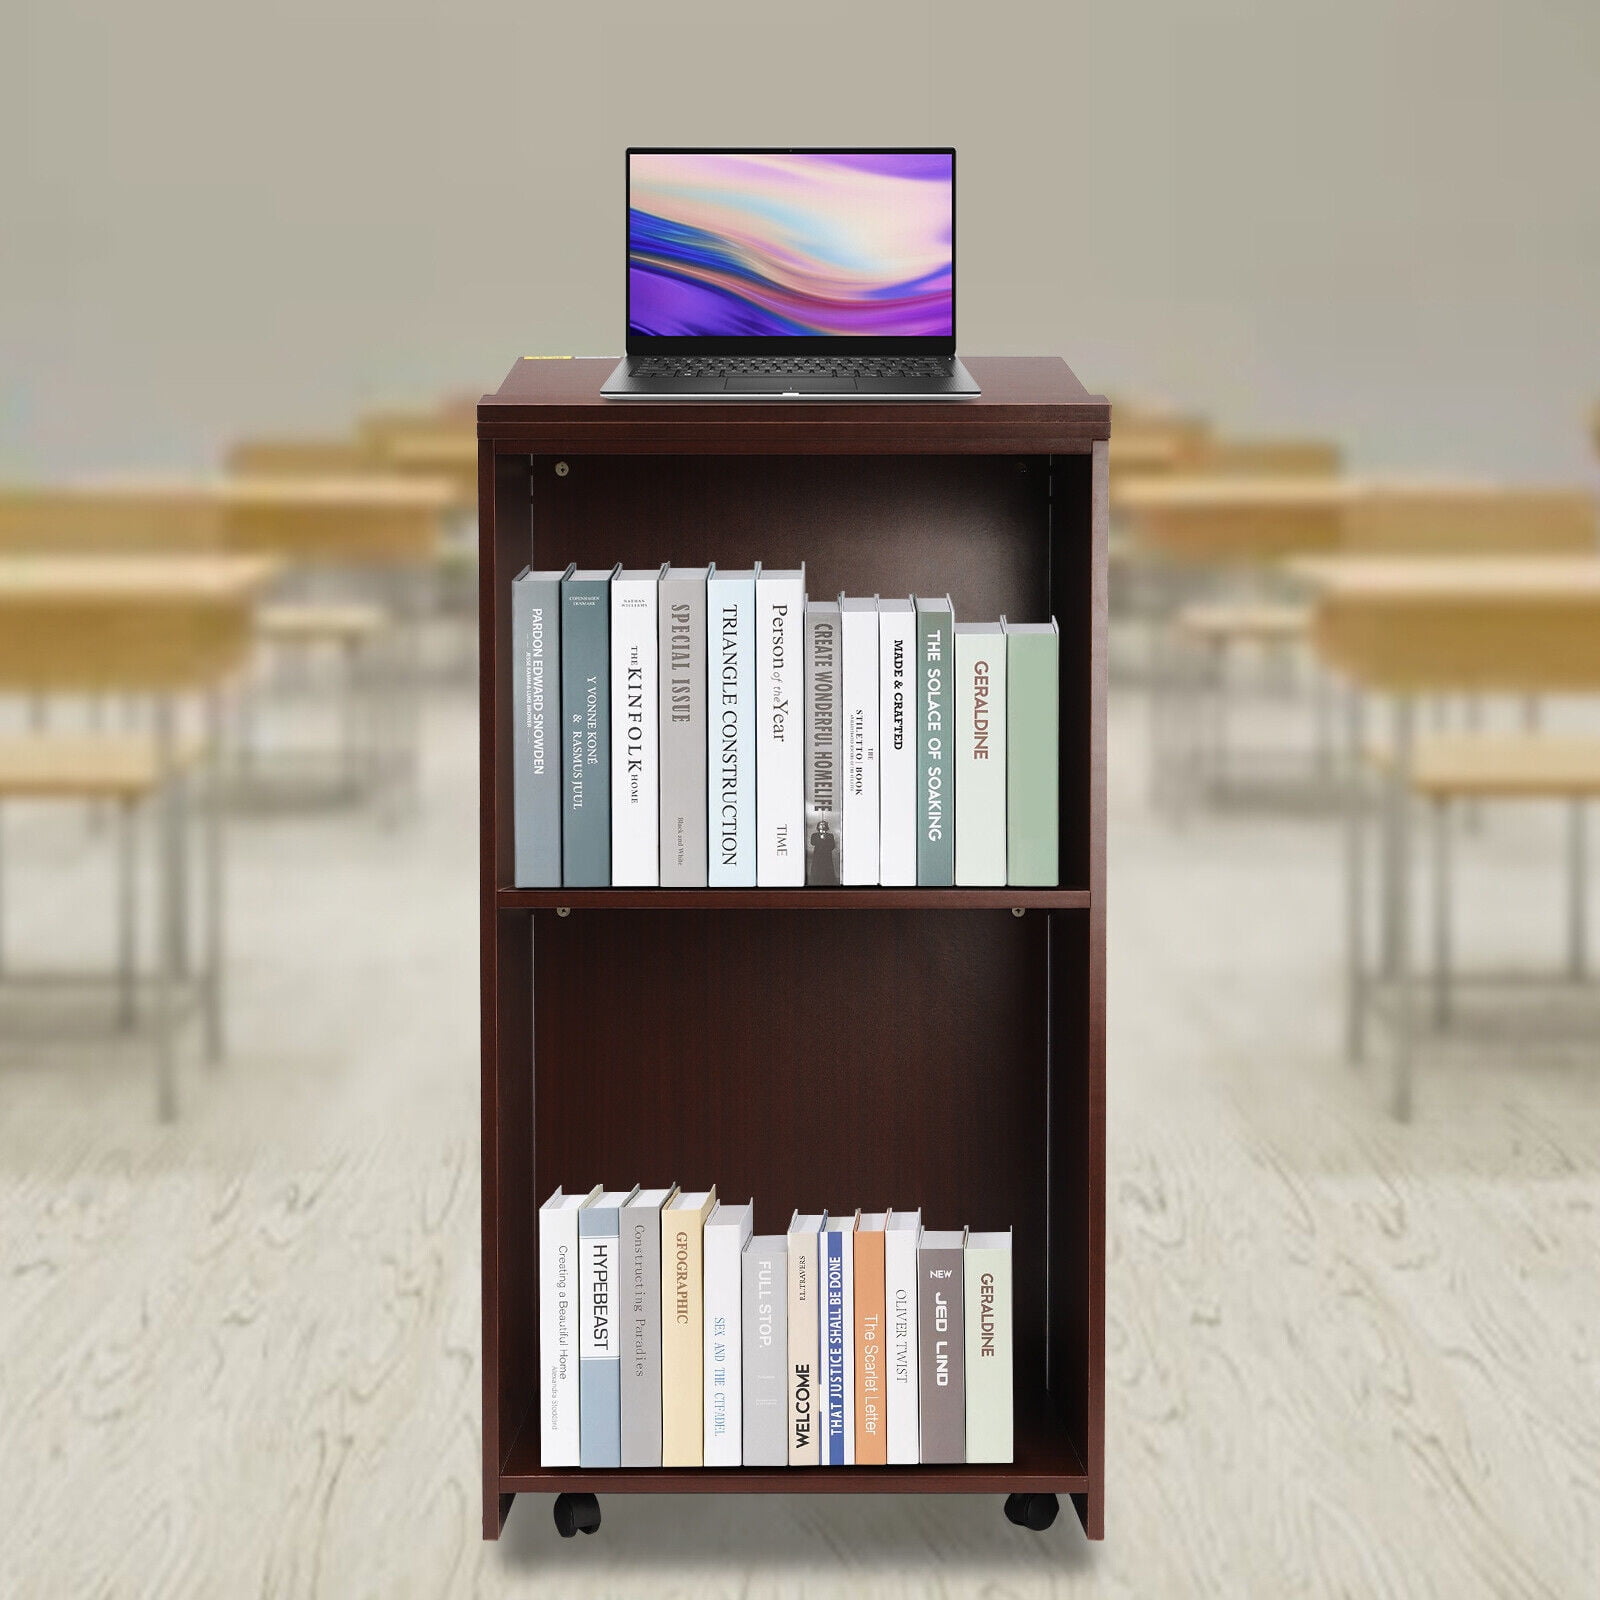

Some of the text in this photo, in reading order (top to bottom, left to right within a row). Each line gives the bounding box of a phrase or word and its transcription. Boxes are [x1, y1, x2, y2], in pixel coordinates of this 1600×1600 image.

[532, 608, 544, 775] PARDON EDWARD SNOWDEN
[671, 604, 690, 723] SPECIAL ISSUE
[770, 604, 789, 742] Person of the Year
[893, 639, 904, 750] MADE & CRAFTED
[974, 660, 989, 760] GERALDINE
[571, 714, 583, 810] & RASMUS JUUL
[587, 732, 599, 764] KONÉ
[627, 646, 642, 804] THE KINFOLK HOME
[721, 604, 738, 866] TRIANGLE CONSTRUCTION
[814, 623, 834, 812] CREATE WONDERFUL HOMELIFE
[927, 630, 942, 842] THE SOLACE OF SOAKING
[776, 824, 788, 856] TIME
[557, 1245, 568, 1288] Creating
[593, 1245, 609, 1351] HYPEBEAST
[633, 1224, 646, 1377] Constructing Paradies
[758, 1261, 772, 1348] FULL STOP.
[930, 1269, 952, 1279] NEW
[558, 1300, 568, 1346] Beautiful
[714, 1317, 725, 1336] SEX
[714, 1343, 726, 1362] AND
[829, 1256, 843, 1436] THAT JUSTICE SHALL BE DONE
[895, 1289, 908, 1383] OLIVER TWIST
[935, 1292, 949, 1387] JED LIND
[980, 1273, 995, 1357] GERALDINE
[559, 1349, 568, 1380] Home
[714, 1368, 726, 1386] THE
[795, 1364, 810, 1449] WELCOME
[864, 1314, 878, 1435] The Scarlet Letter
